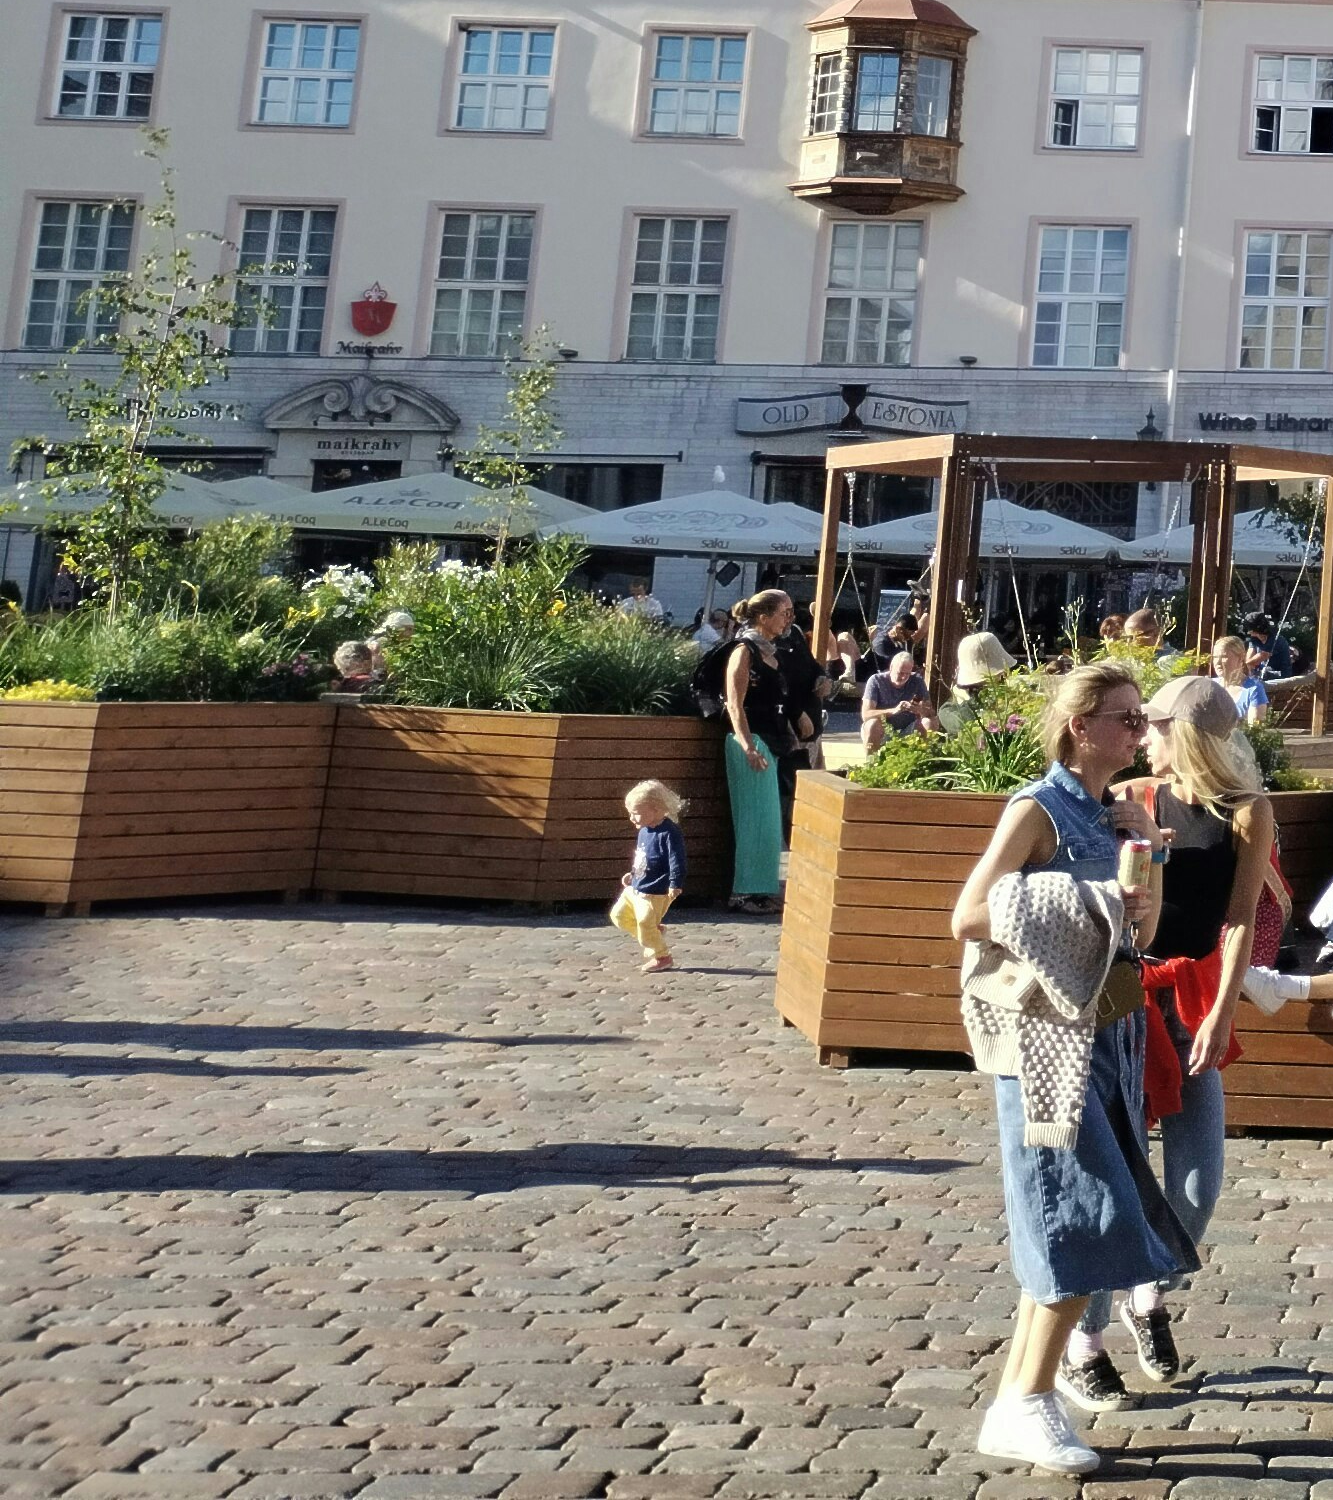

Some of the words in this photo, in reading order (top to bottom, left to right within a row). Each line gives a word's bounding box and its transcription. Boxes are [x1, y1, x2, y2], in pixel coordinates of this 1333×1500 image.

[762, 404, 809, 424] OLD
[872, 403, 956, 428] ESTONIA
[1198, 412, 1257, 431] Wine
[317, 438, 401, 450] maikrahv
[361, 516, 409, 529] A.LeCoq
